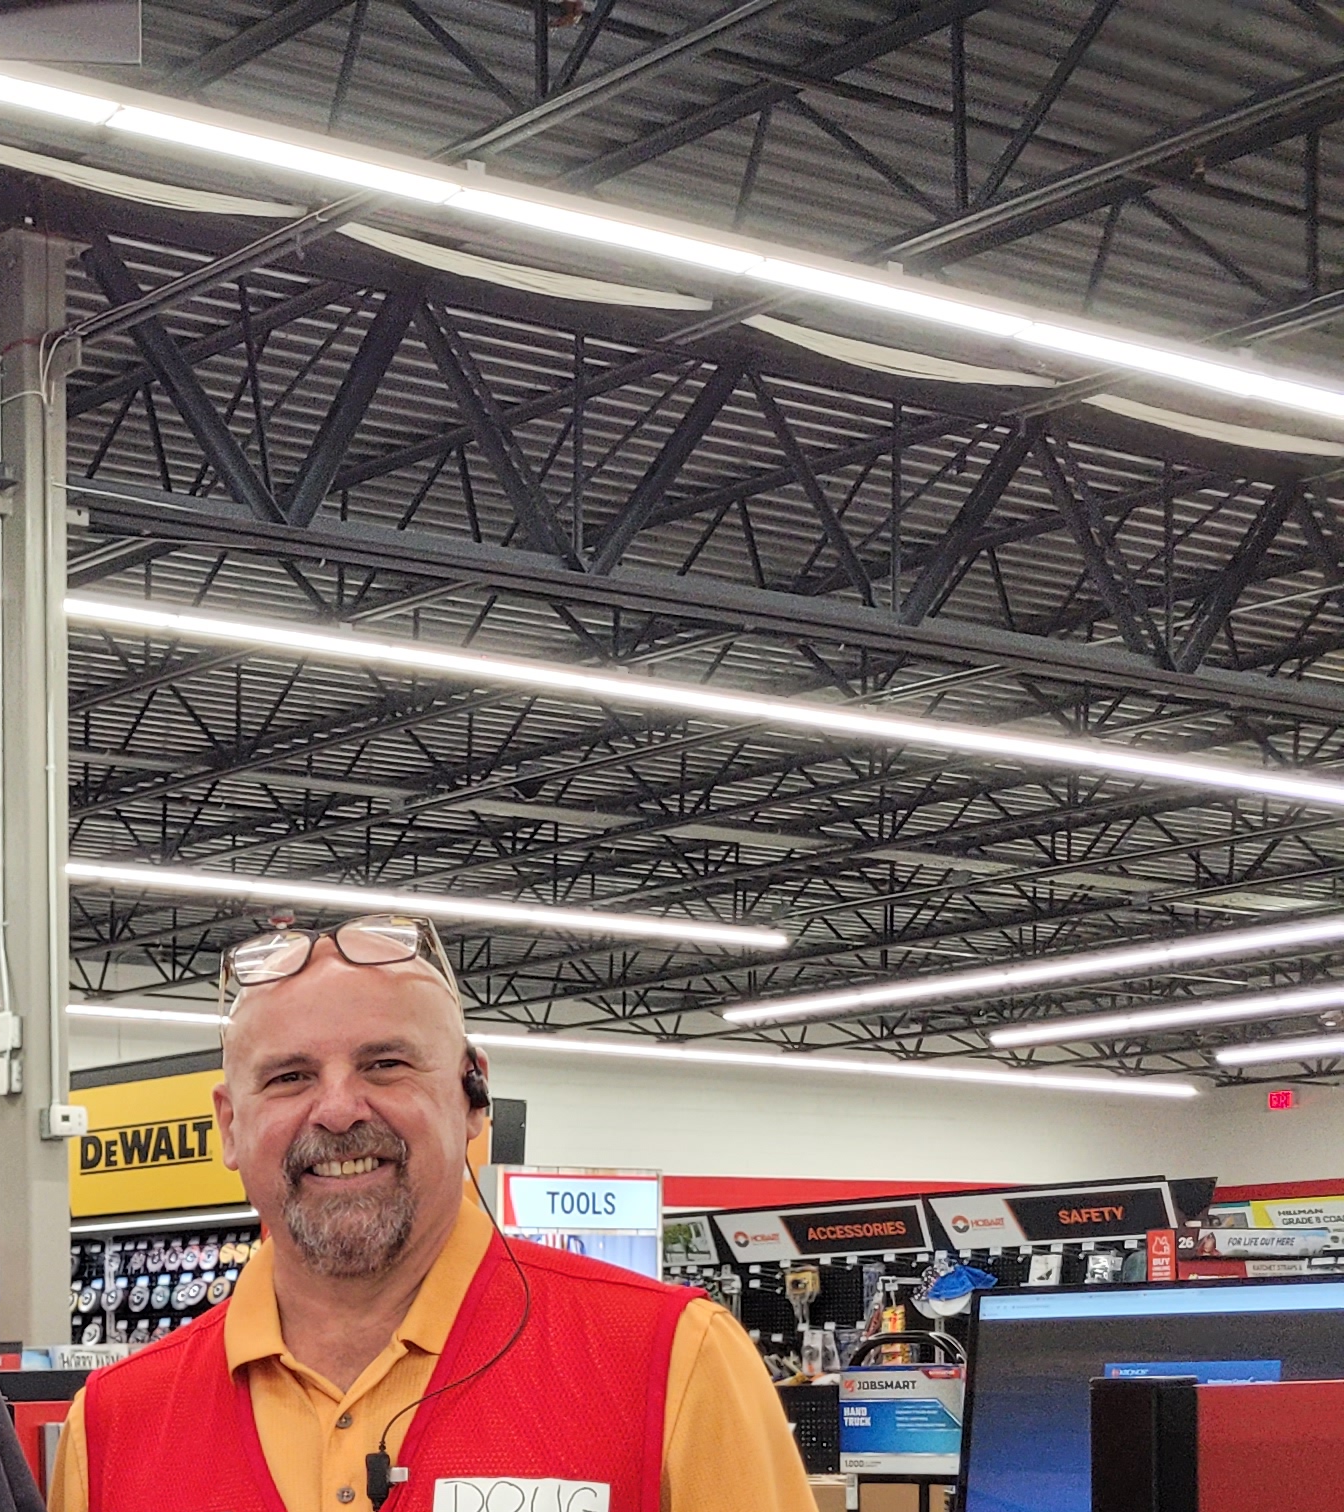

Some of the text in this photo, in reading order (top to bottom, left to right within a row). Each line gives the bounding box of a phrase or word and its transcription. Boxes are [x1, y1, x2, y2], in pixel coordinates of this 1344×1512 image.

[546, 1191, 616, 1216] TOOLS
[1058, 1206, 1124, 1225] SAFETY
[1282, 1216, 1313, 1226] GRADE
[806, 1221, 907, 1241] ACCESSORIES
[1178, 1236, 1194, 1249] 26
[1228, 1236, 1296, 1247] FOR LIFE OUT HERE
[1152, 1258, 1170, 1267] BUY
[857, 1380, 917, 1391] JOBSMART
[843, 1407, 867, 1417] HAND
[844, 1416, 871, 1427] TRUCK
